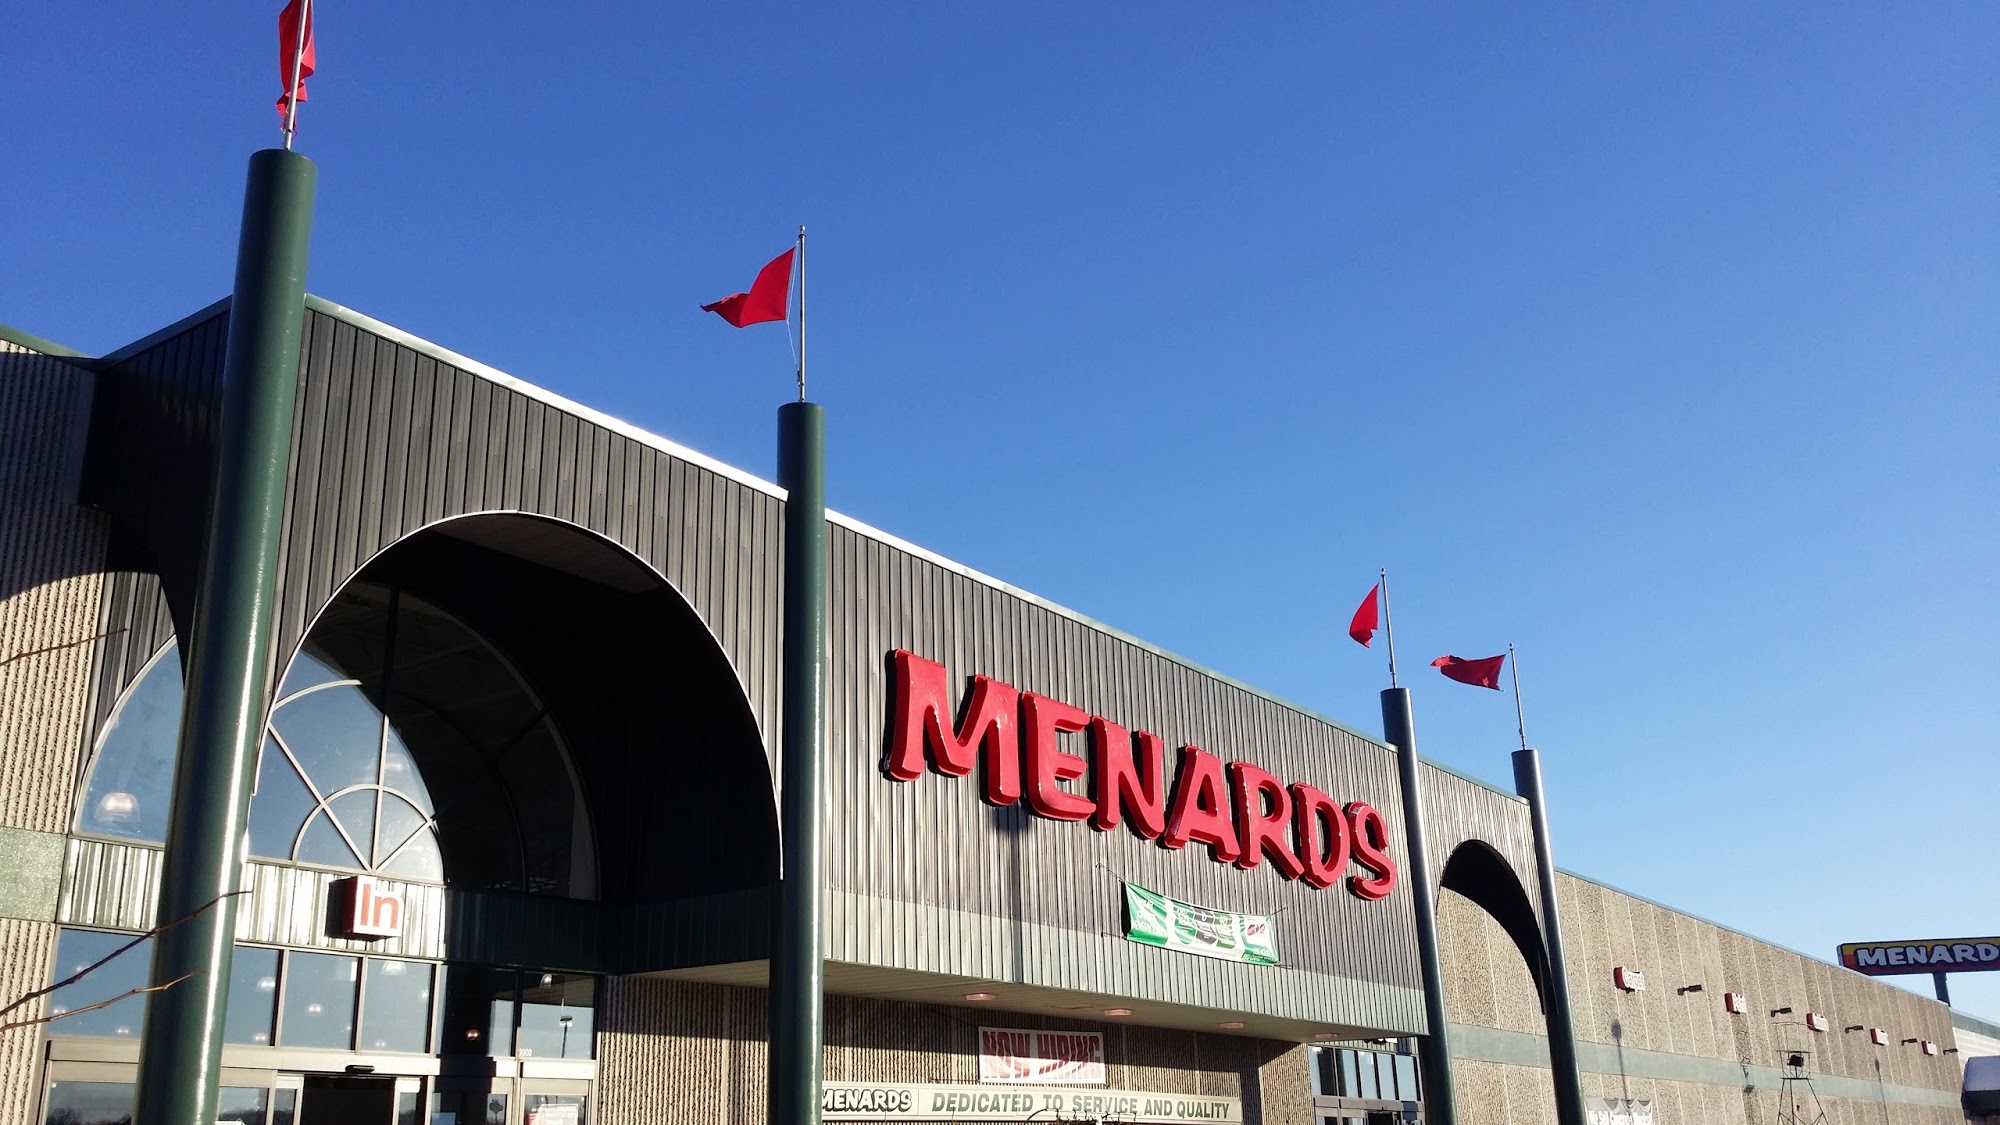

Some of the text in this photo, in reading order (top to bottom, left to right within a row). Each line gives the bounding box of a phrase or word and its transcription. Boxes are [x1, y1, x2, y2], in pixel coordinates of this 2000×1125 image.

[883, 648, 1398, 901] MENARDS
[359, 883, 400, 929] In
[982, 1030, 1102, 1080] NOW HIRING
[932, 1092, 1034, 1113] DEDICATED
[1042, 1094, 1064, 1112] TO
[1072, 1094, 1138, 1114] SERVICE
[1143, 1098, 1173, 1117] AND
[1176, 1100, 1230, 1119] QUALITY
